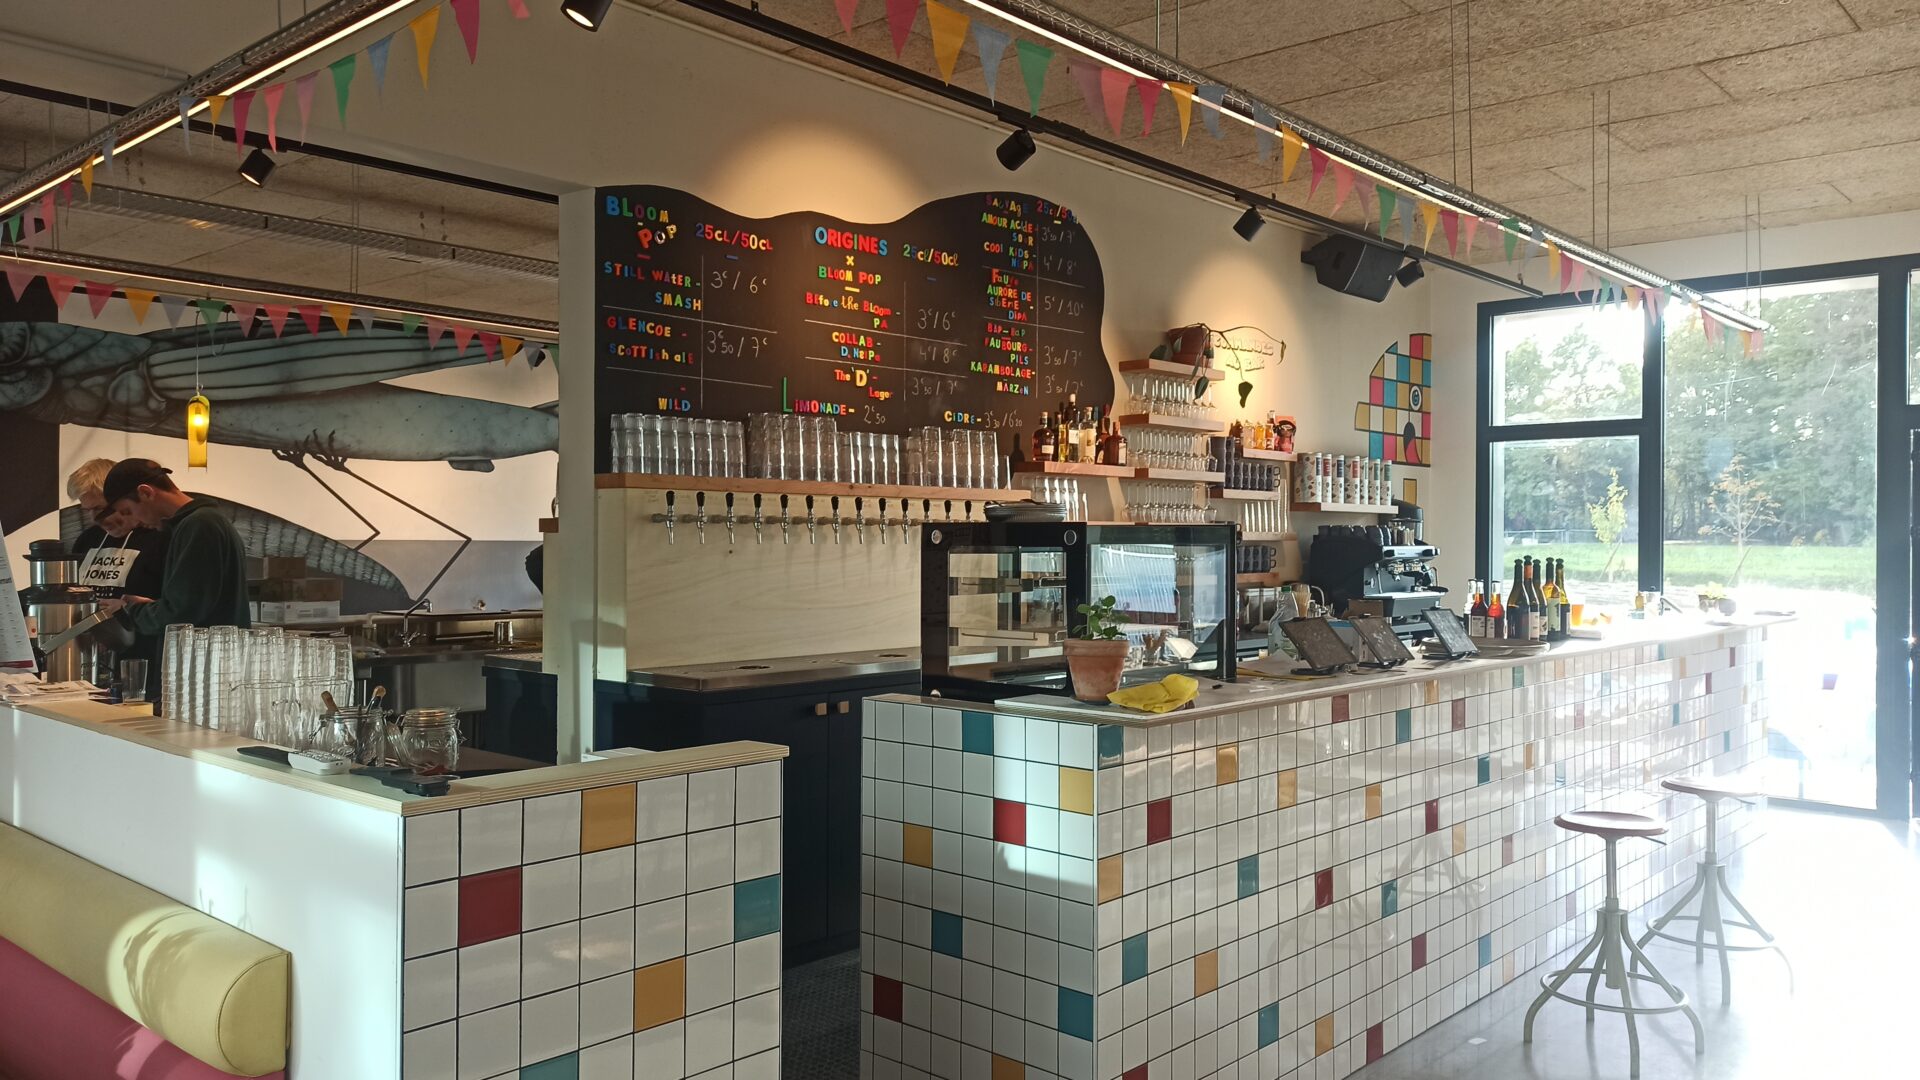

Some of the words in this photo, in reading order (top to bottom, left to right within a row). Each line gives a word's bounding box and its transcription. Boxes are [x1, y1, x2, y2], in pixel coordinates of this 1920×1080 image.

[606, 195, 669, 223] BLOOM
[982, 212, 1008, 229] AMOUR
[637, 224, 677, 249] POP
[815, 226, 888, 256] ORIGINES
[604, 261, 645, 280] STILL
[818, 266, 853, 282] BLOOM
[858, 271, 882, 285] POP
[655, 291, 702, 311] SMASH
[986, 284, 1019, 299] AURORE
[1021, 291, 1032, 302] DE
[607, 316, 671, 338] GLENCOE
[873, 318, 888, 329] PA
[832, 331, 874, 348] COLLAB
[1010, 353, 1029, 365] PILS
[834, 369, 851, 382] The
[658, 397, 691, 412] WILD
[83, 569, 120, 580] JONES
